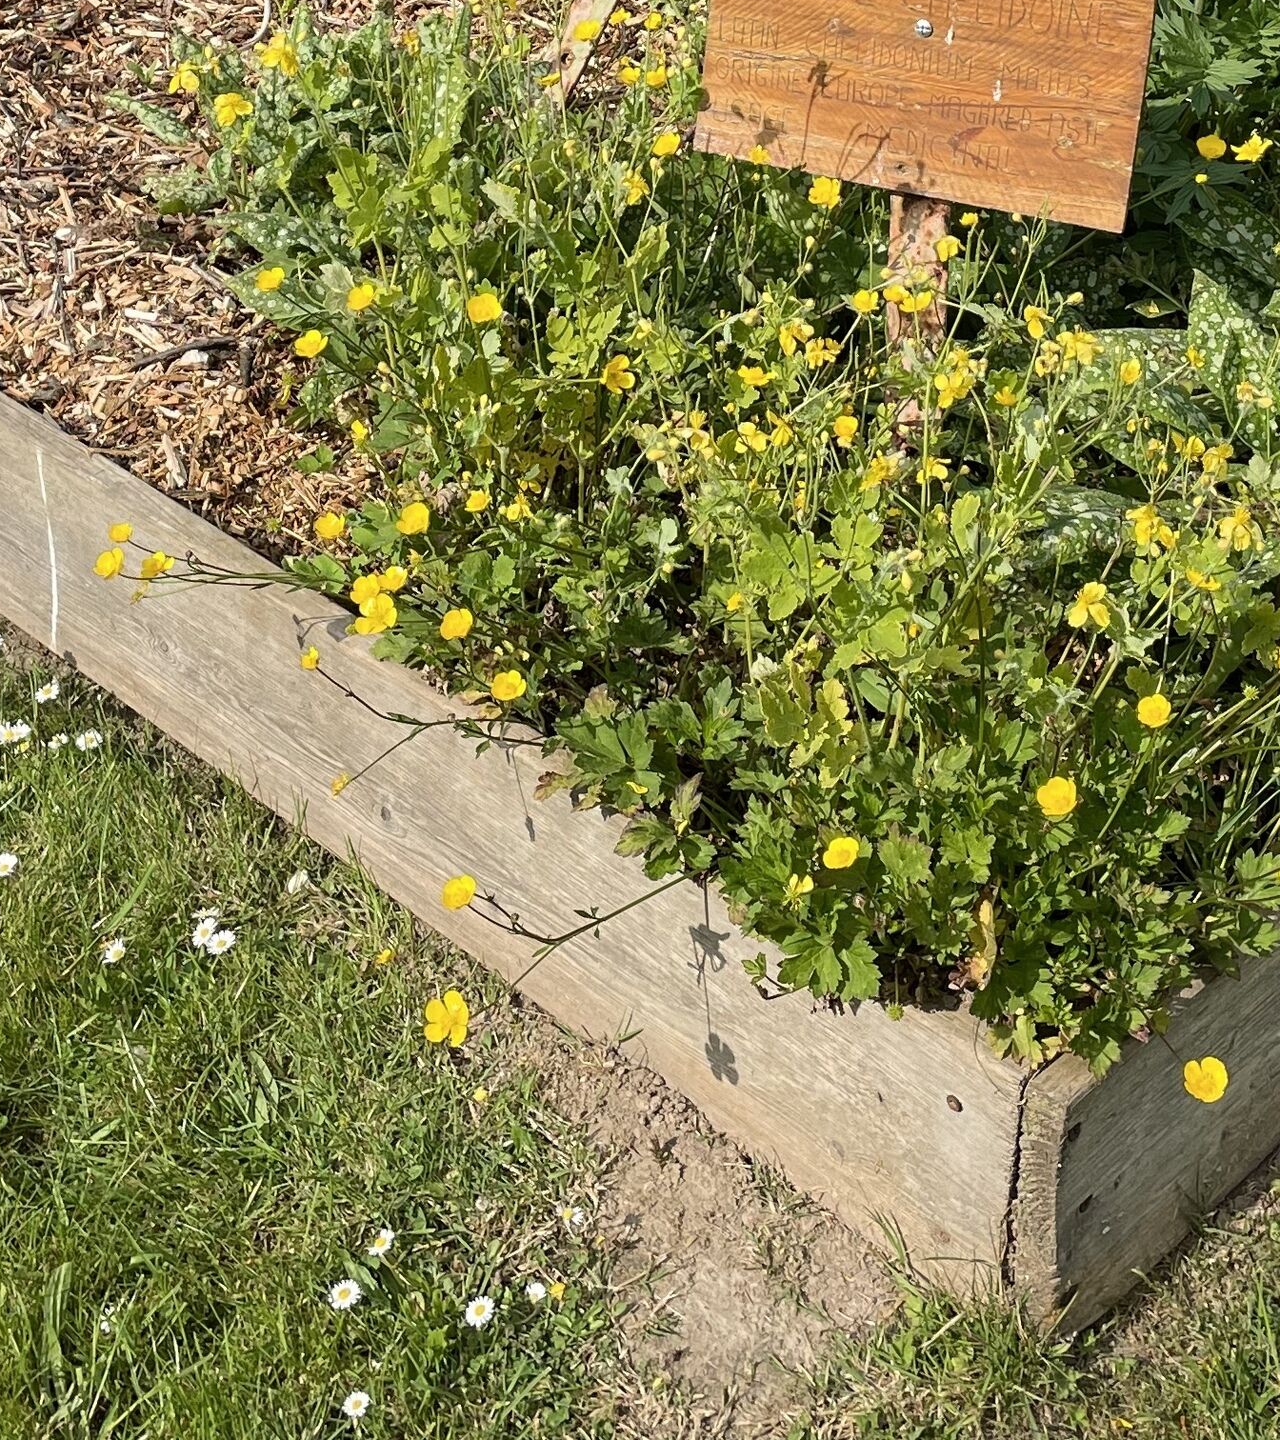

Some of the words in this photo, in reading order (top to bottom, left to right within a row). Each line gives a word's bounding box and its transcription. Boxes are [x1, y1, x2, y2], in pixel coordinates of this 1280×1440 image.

[715, 56, 806, 96] ORIGINE
[718, 14, 780, 50] LATIN
[1001, 63, 1093, 99] MAJUS
